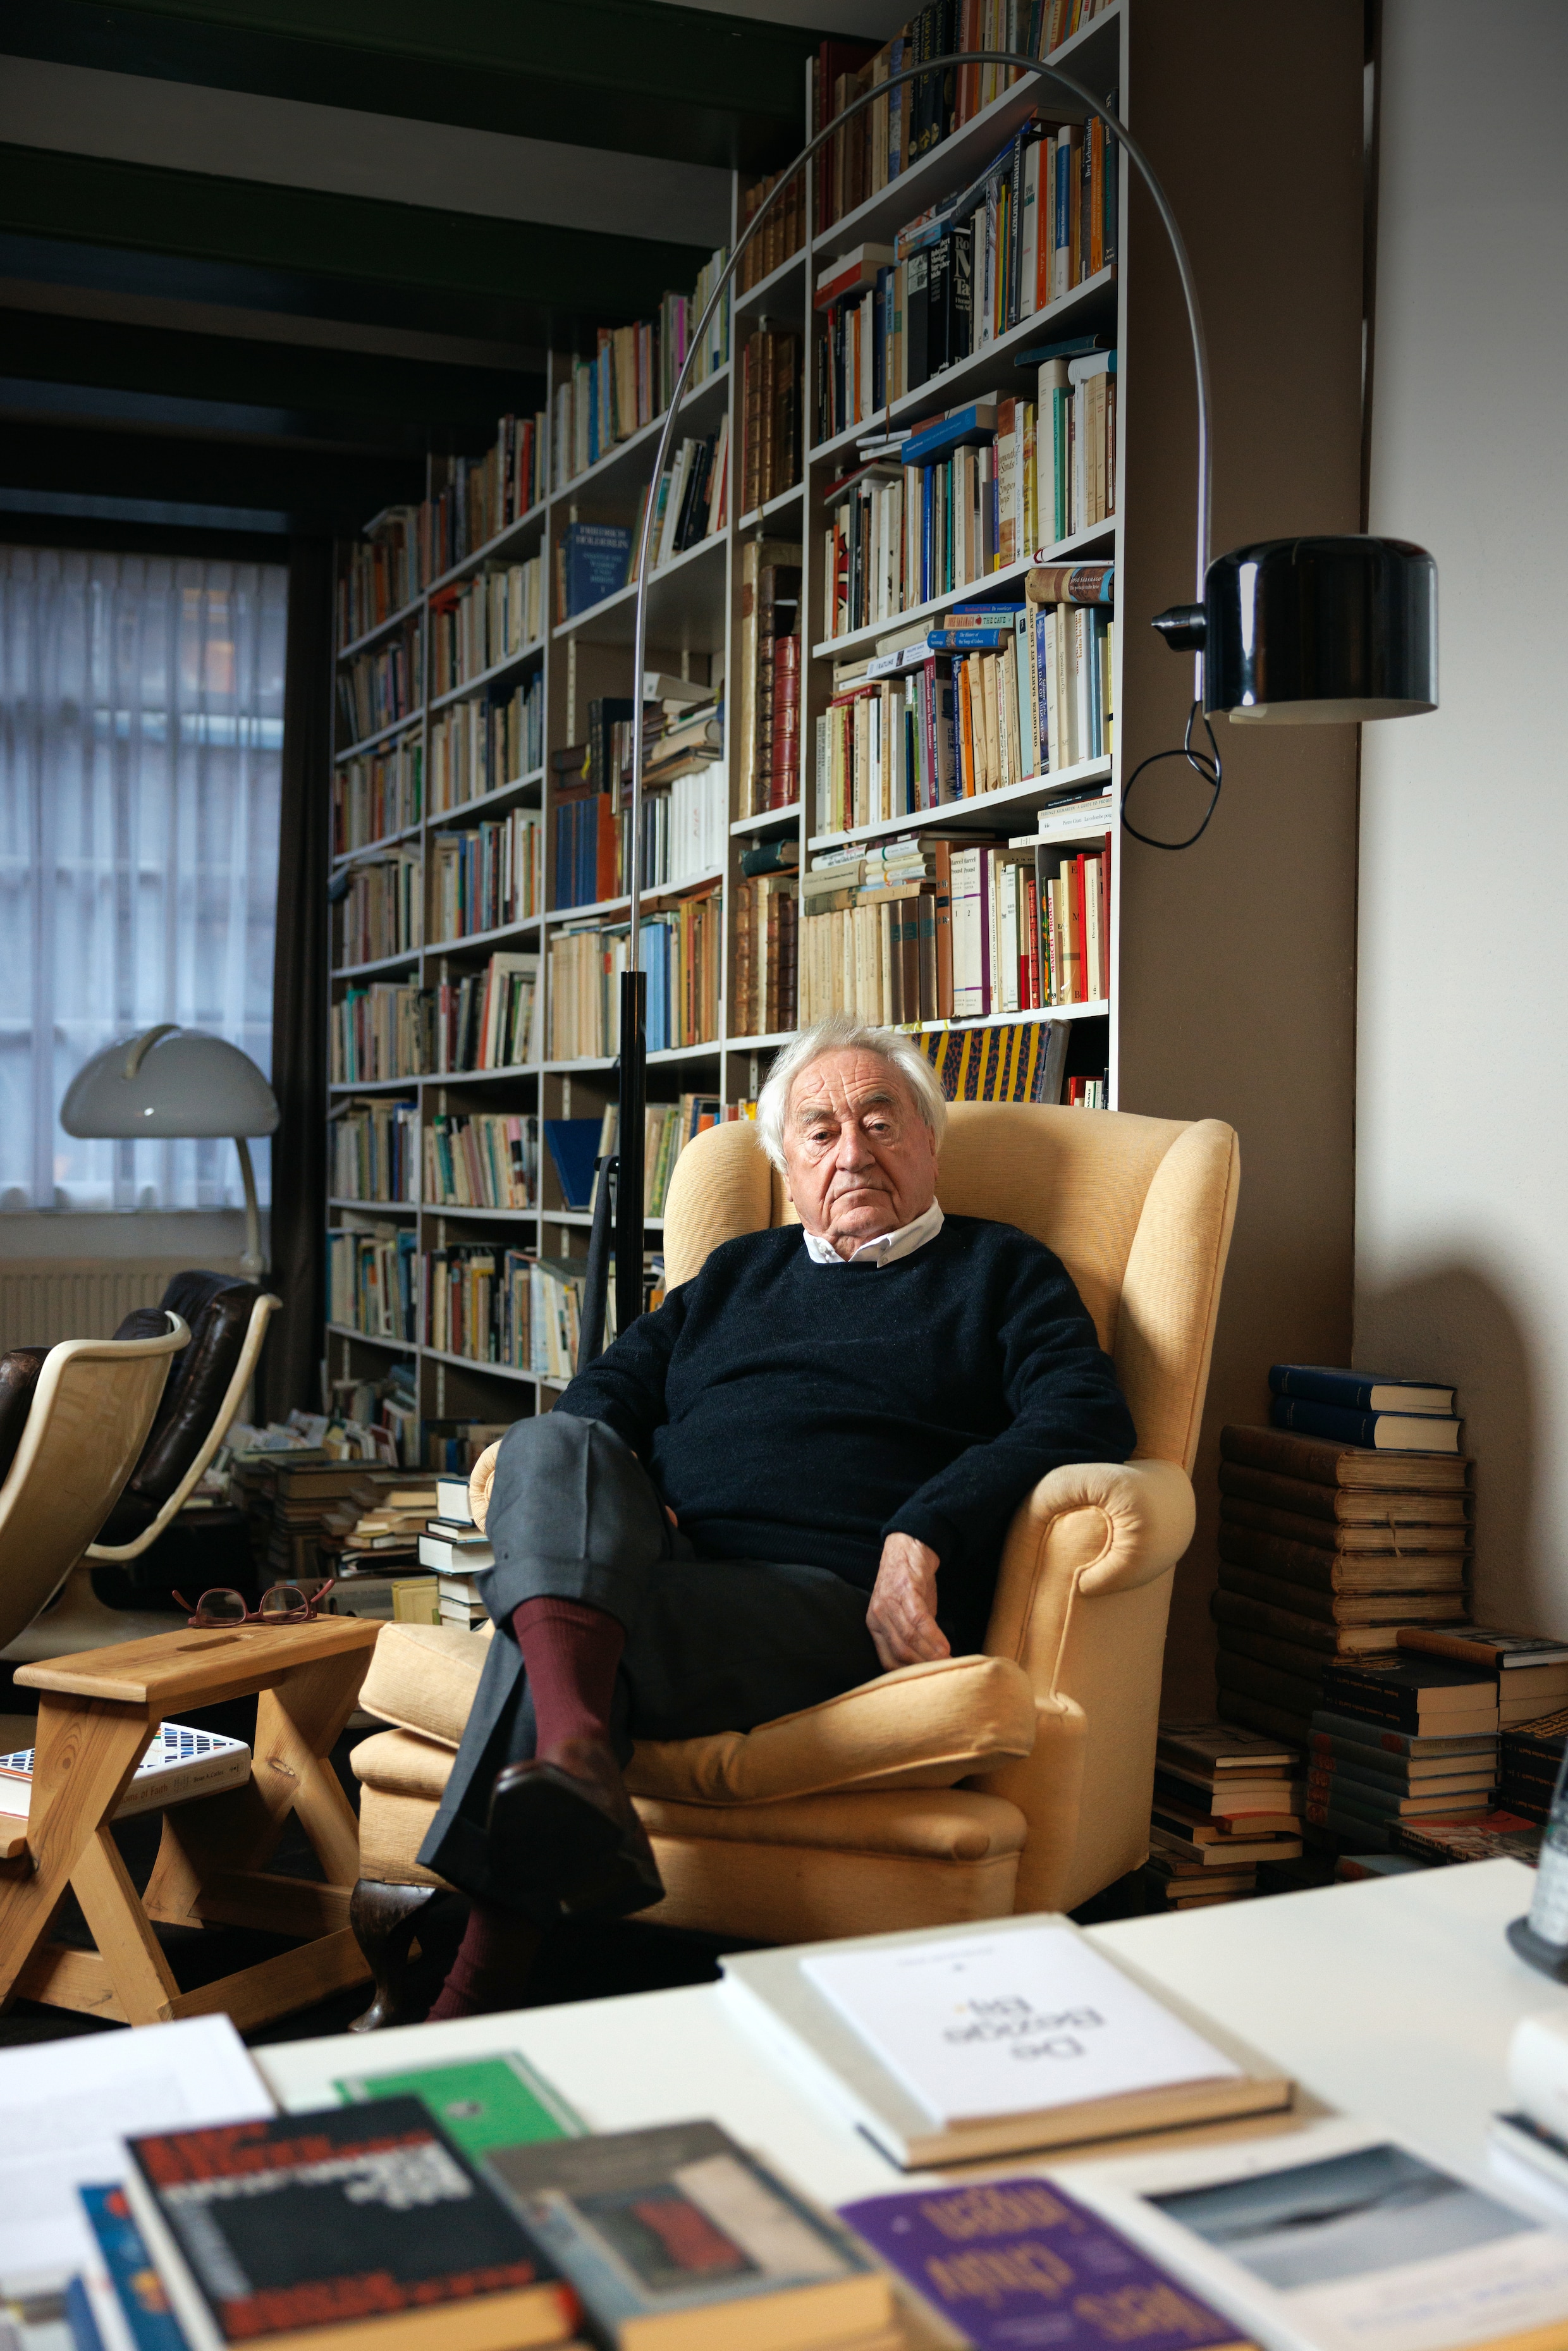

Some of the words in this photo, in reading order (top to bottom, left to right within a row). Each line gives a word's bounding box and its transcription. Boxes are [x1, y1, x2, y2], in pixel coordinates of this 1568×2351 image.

[579, 525, 627, 538] FRIEDRICH
[956, 617, 974, 627] SARAMAGO
[878, 658, 894, 670] RATLINE
[140, 1791, 148, 1799] of
[150, 1783, 168, 1796] Faith
[211, 1770, 224, 1778] Catlos
[1011, 2036, 1086, 2060] De
